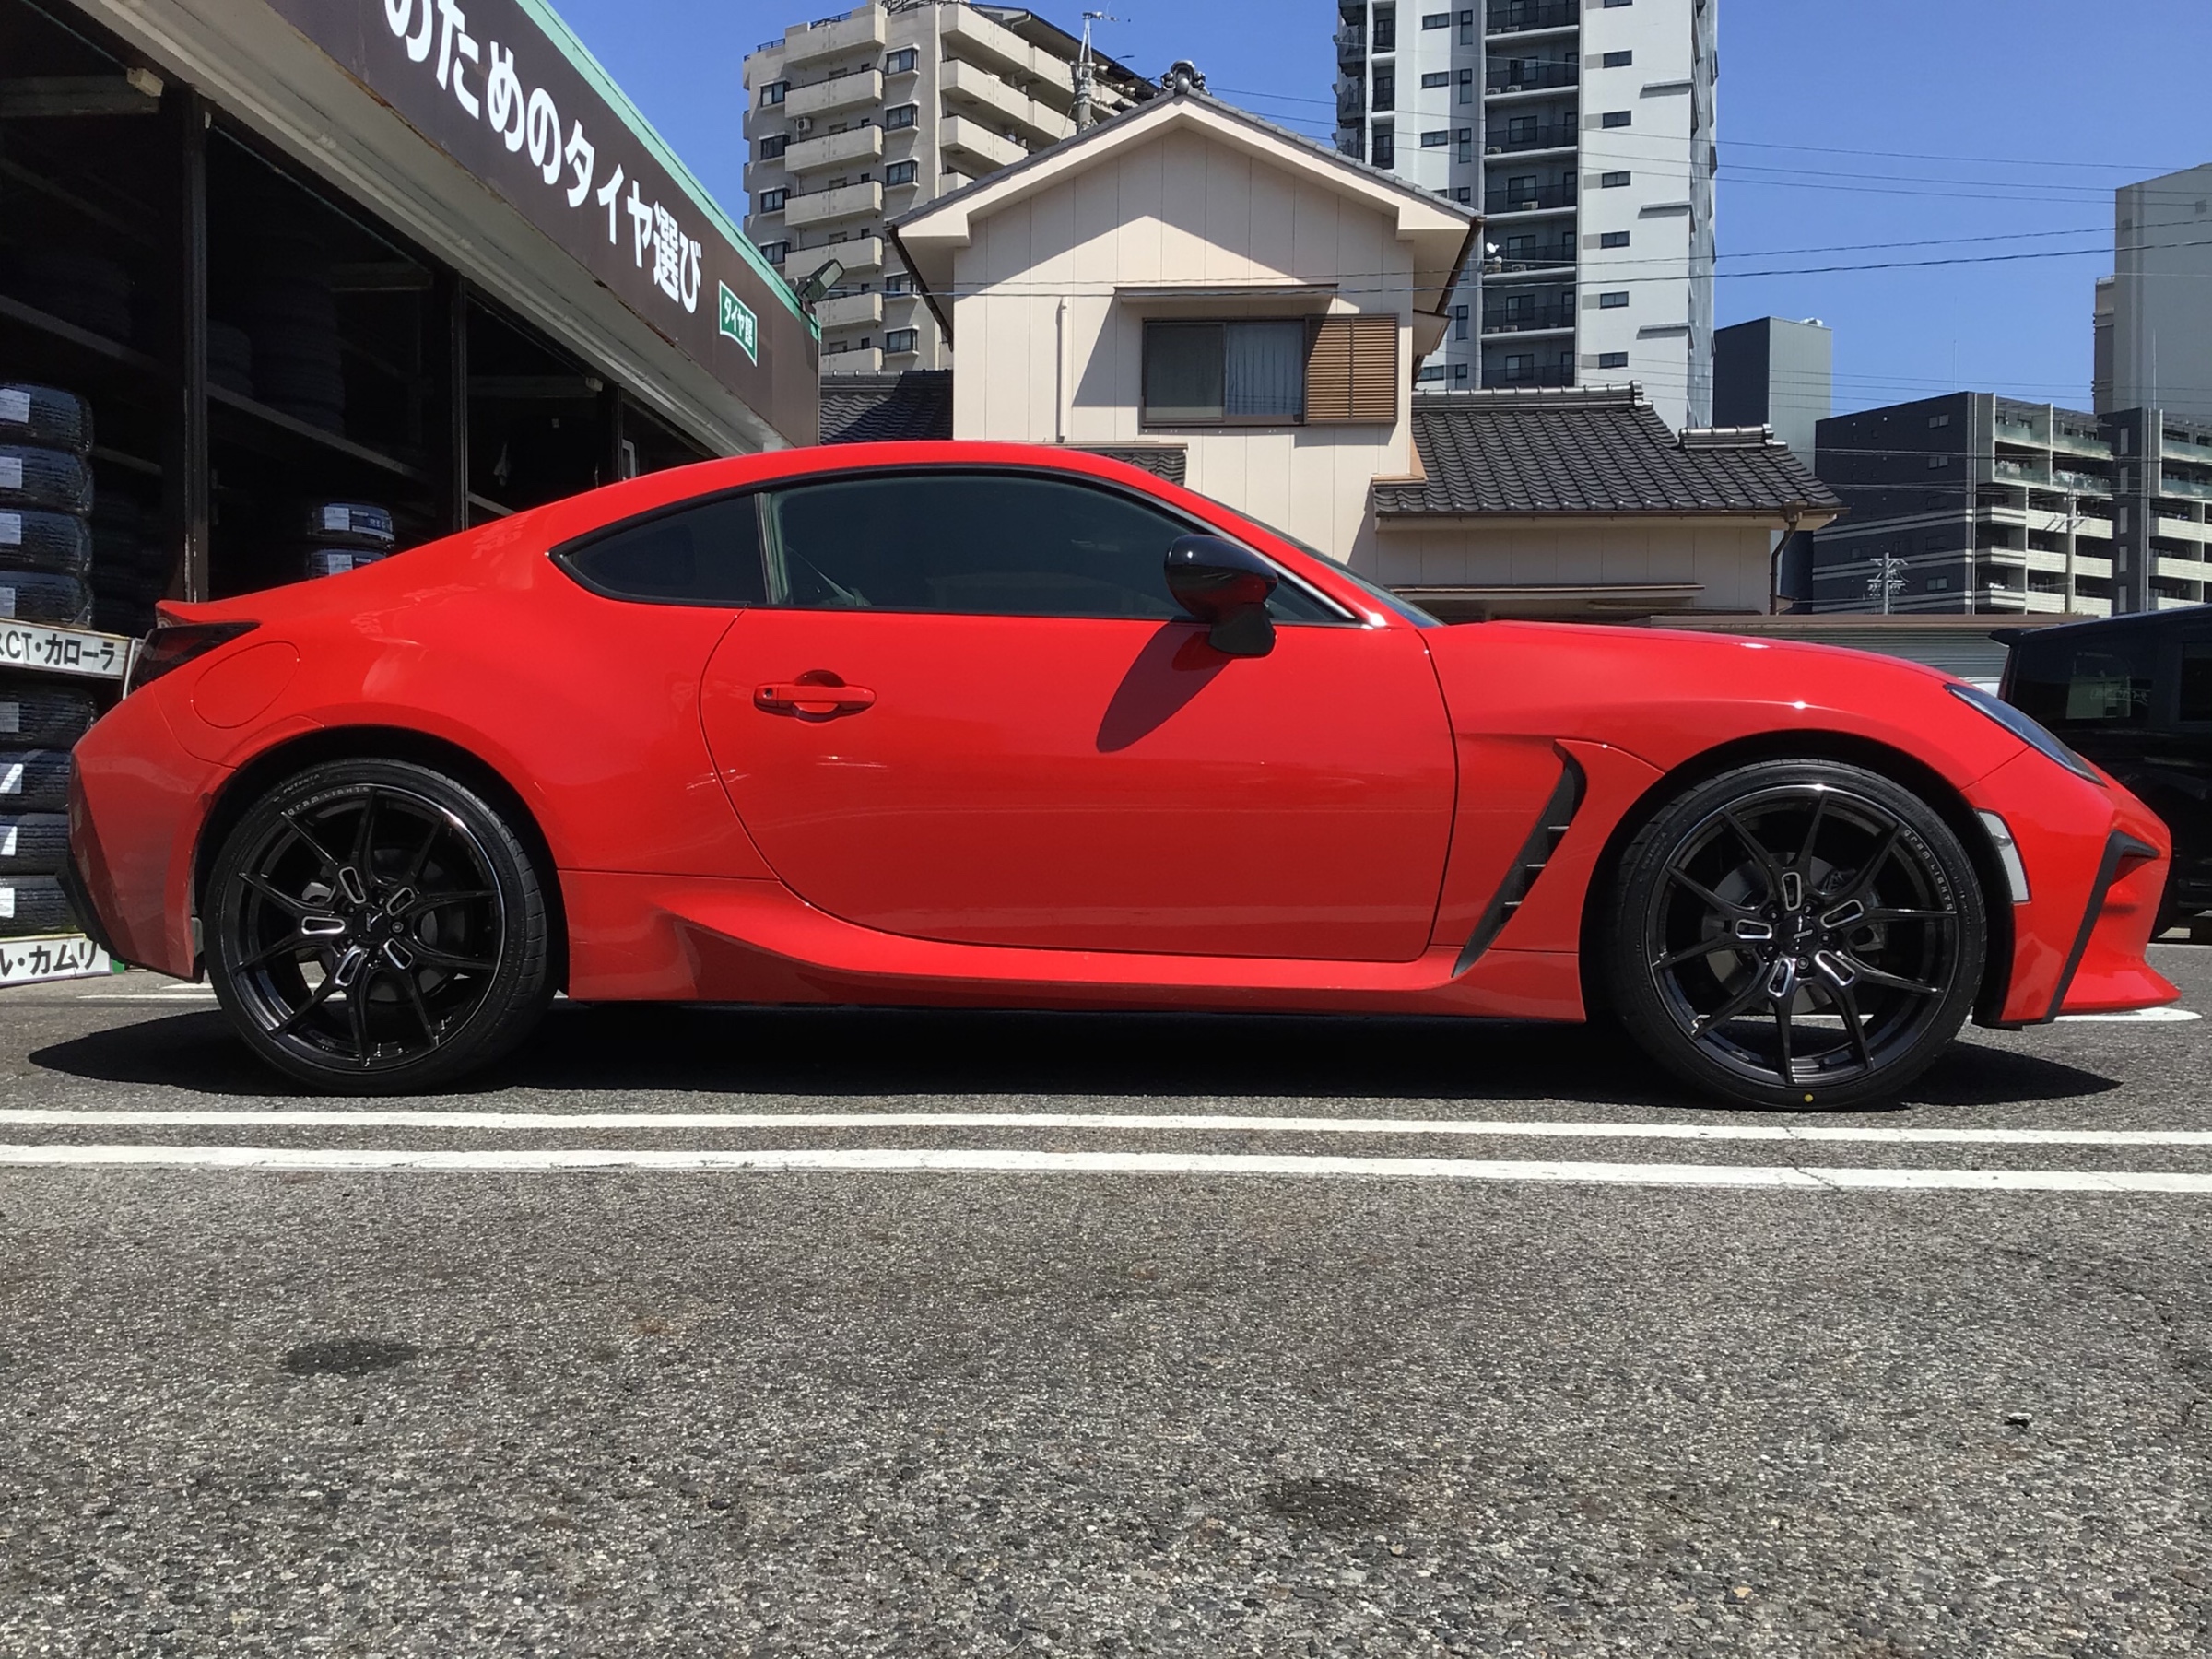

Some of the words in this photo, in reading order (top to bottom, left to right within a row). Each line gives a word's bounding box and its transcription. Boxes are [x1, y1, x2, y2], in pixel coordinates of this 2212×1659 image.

[384, 0, 702, 314] のためのタイヤ選び
[724, 296, 754, 348] タイヤ館
[288, 796, 319, 816] gram
[324, 786, 370, 798] LIGHTS
[1904, 830, 1931, 859] gram
[1931, 864, 1953, 911] LIGHTS
